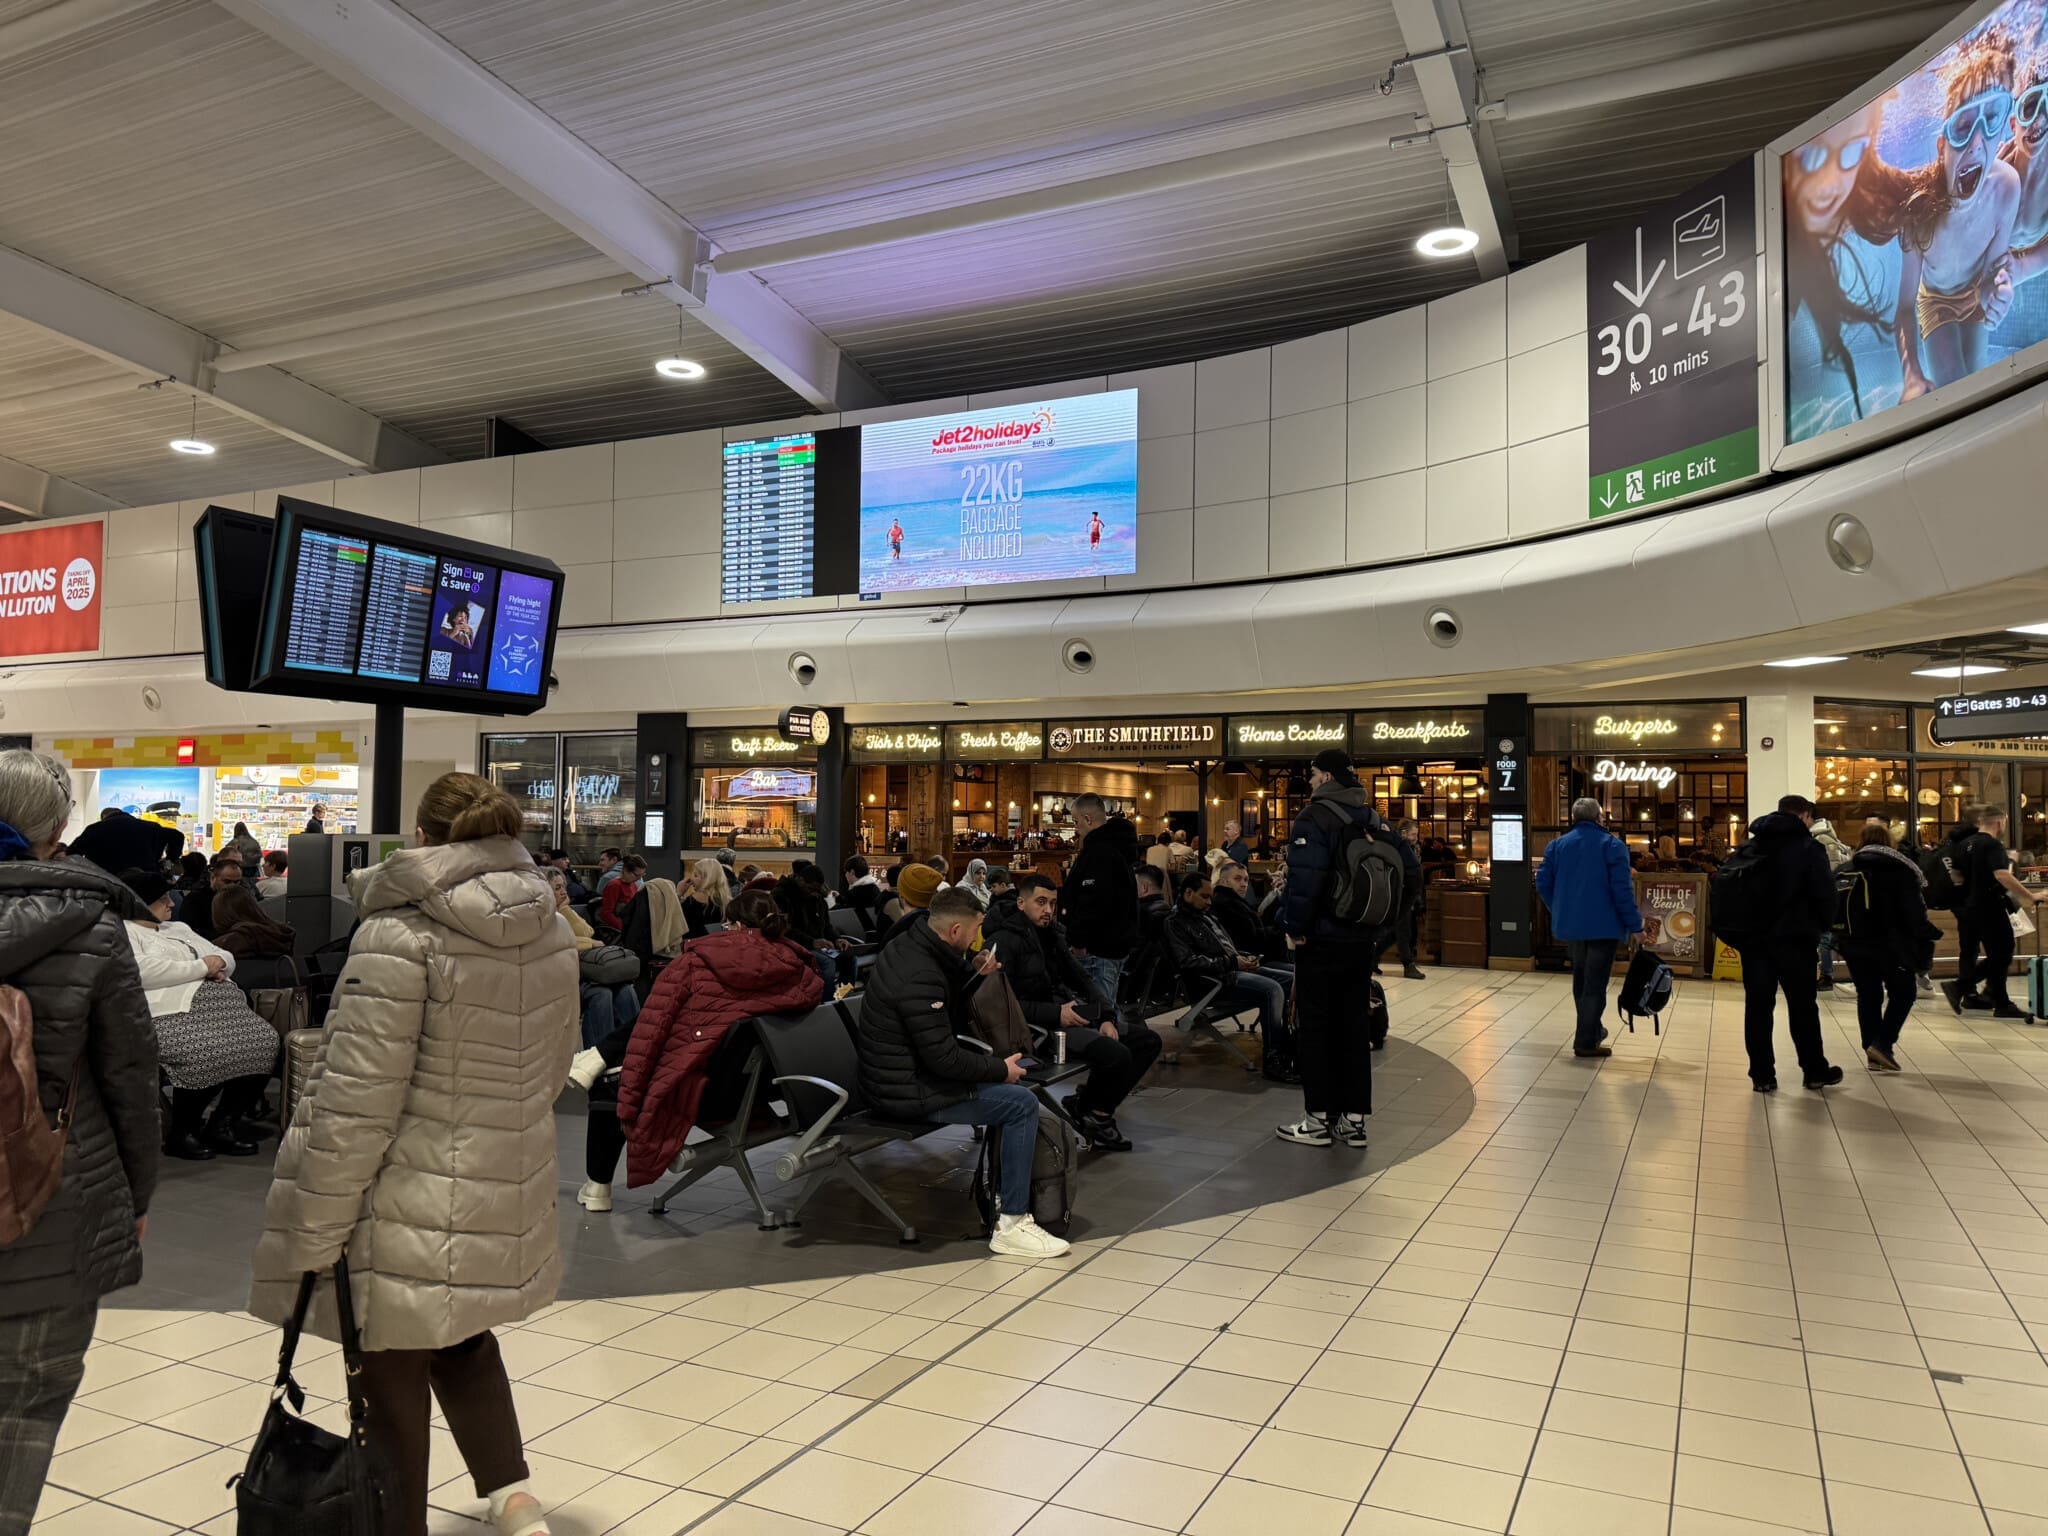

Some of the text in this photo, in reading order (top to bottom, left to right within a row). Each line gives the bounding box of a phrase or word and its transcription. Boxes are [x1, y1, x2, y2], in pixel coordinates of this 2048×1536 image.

[1649, 350, 1709, 385] 10 mins
[932, 420, 1041, 446] Jet2holidays
[1653, 456, 1716, 491] Fire Exit
[961, 461, 1023, 507] 22KG
[960, 503, 1022, 535] BAGGAGE
[960, 532, 1022, 561] INCLUDED
[67, 576, 90, 588] APRIL
[443, 563, 484, 582] Sign up
[67, 587, 90, 600] 2025
[441, 576, 471, 592] & save
[7, 594, 57, 617] LUTON
[1970, 700, 2002, 711] Gates
[1073, 728, 1105, 744] THE
[1109, 725, 1214, 743] SMITHFIELD
[1239, 723, 1345, 743] Home Cooked
[1372, 721, 1470, 744] Breakfasts
[1593, 715, 1678, 741] Burgers
[731, 738, 762, 757] Craft
[763, 737, 799, 752] Beers
[866, 733, 942, 752] Fish & Chips
[960, 731, 998, 748] Fresh
[1000, 731, 1042, 752] Coffee
[1978, 741, 1996, 749] PUB
[2000, 742, 2019, 750] AND
[1496, 760, 1517, 768] FOOD
[751, 771, 780, 787] Bar
[1502, 771, 1512, 787] 7
[1593, 760, 1677, 789] Dining
[652, 779, 659, 791] 7
[1646, 888, 1691, 900] FULL OF
[1651, 896, 1685, 909] Beans
